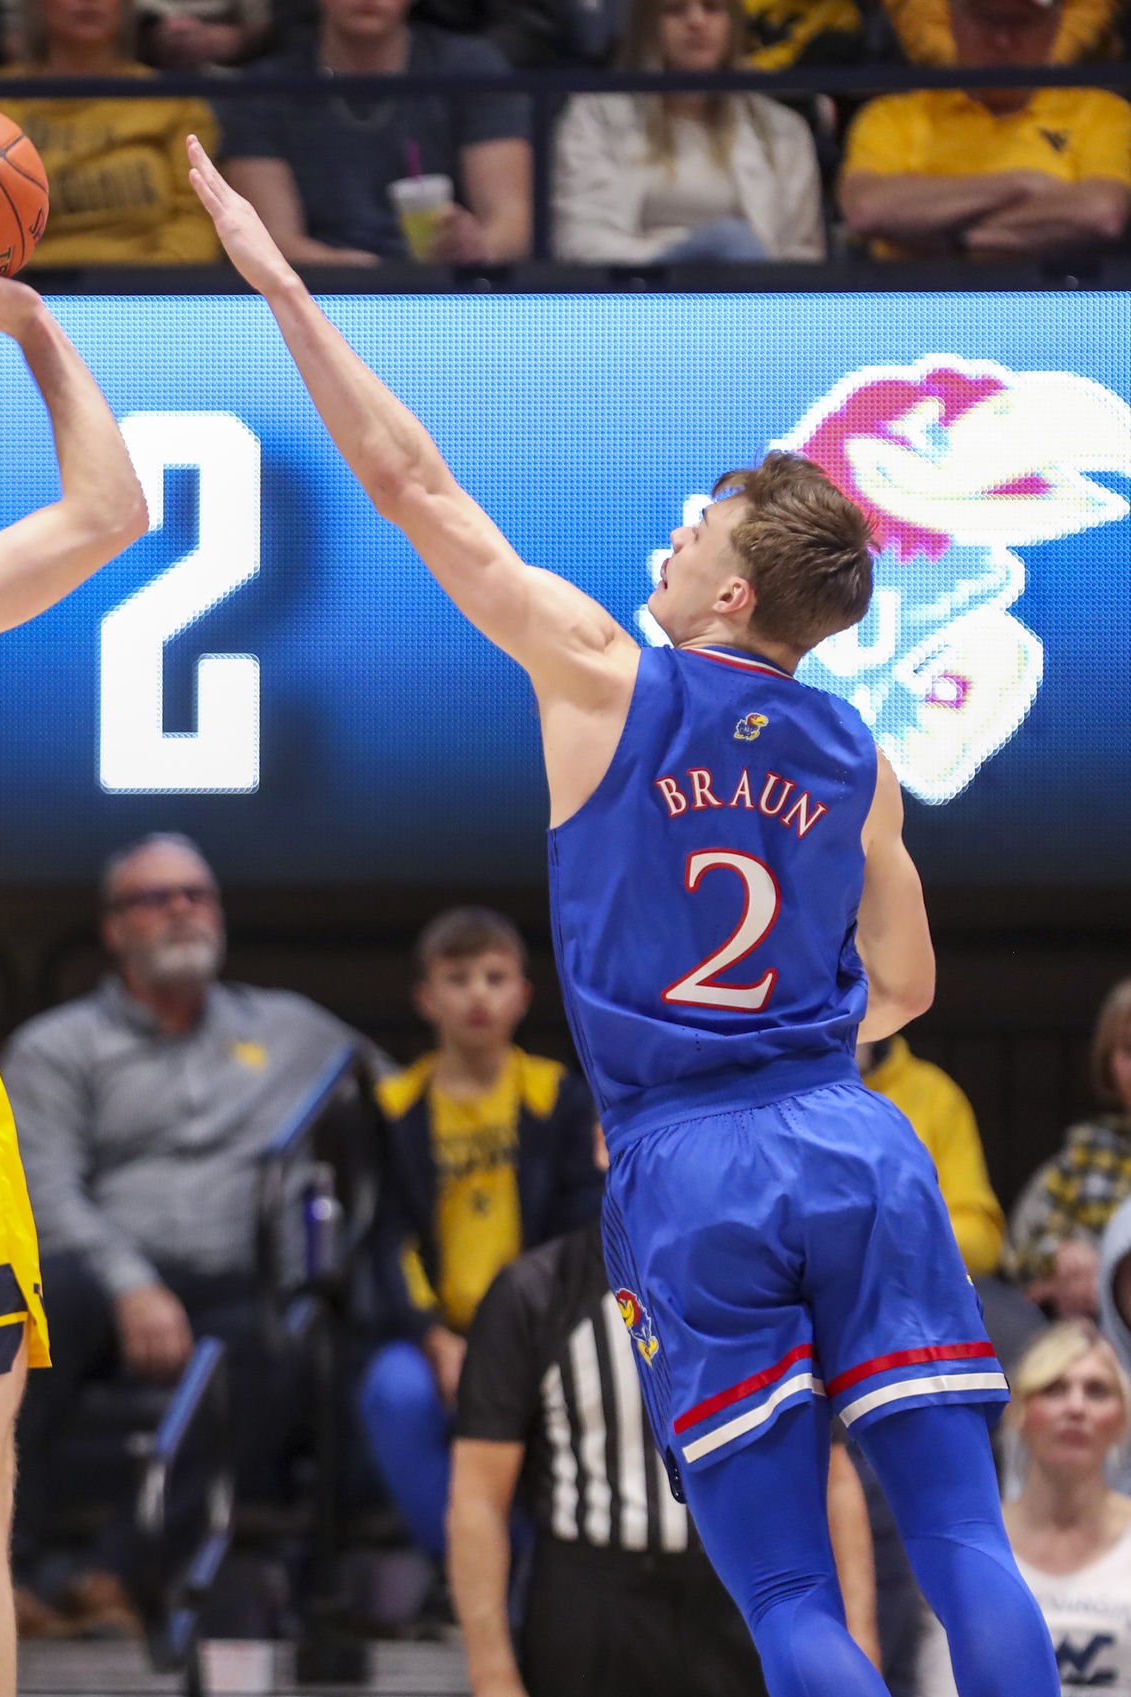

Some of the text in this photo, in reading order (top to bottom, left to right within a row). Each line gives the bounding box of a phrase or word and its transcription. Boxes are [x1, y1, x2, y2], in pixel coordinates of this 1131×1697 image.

[97, 410, 261, 794] 2
[654, 767, 828, 839] BRAUN
[661, 847, 782, 1013] 2
